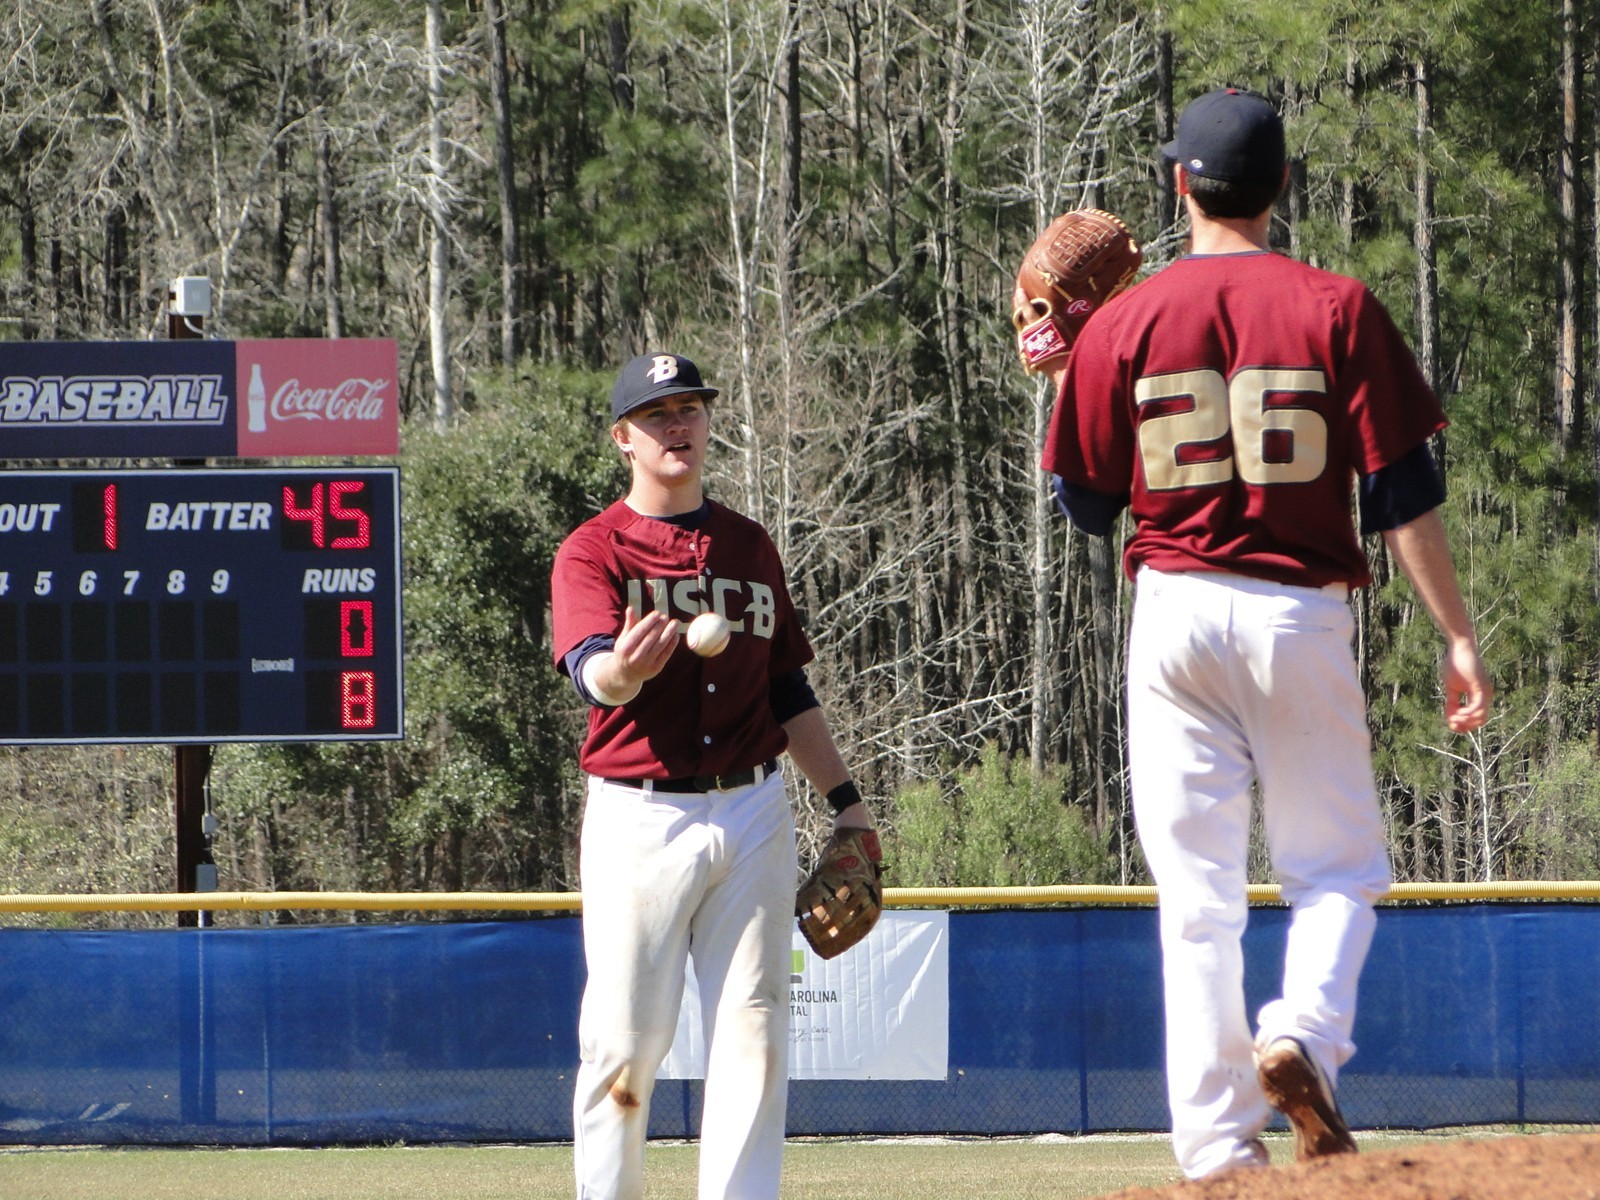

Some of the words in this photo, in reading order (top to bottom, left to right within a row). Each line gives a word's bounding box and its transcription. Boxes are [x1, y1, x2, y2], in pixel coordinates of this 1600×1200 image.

[646, 355, 679, 385] B
[0, 376, 228, 427] BASEBALL
[271, 378, 390, 420] Coca-Cola
[1134, 366, 1328, 492] 26
[0, 503, 61, 532] OUT
[104, 483, 118, 550] 1
[145, 501, 272, 531] BATTER
[282, 481, 371, 549] 45
[34, 570, 53, 596] 5
[79, 570, 98, 596] 6
[123, 570, 141, 595] 7
[166, 569, 186, 594] 8
[210, 569, 230, 594] 9
[301, 568, 377, 593] RUNS
[340, 601, 374, 657] 0
[341, 671, 375, 728] 8
[789, 990, 838, 1003] AROLINA
[789, 1005, 808, 1017] TAL
